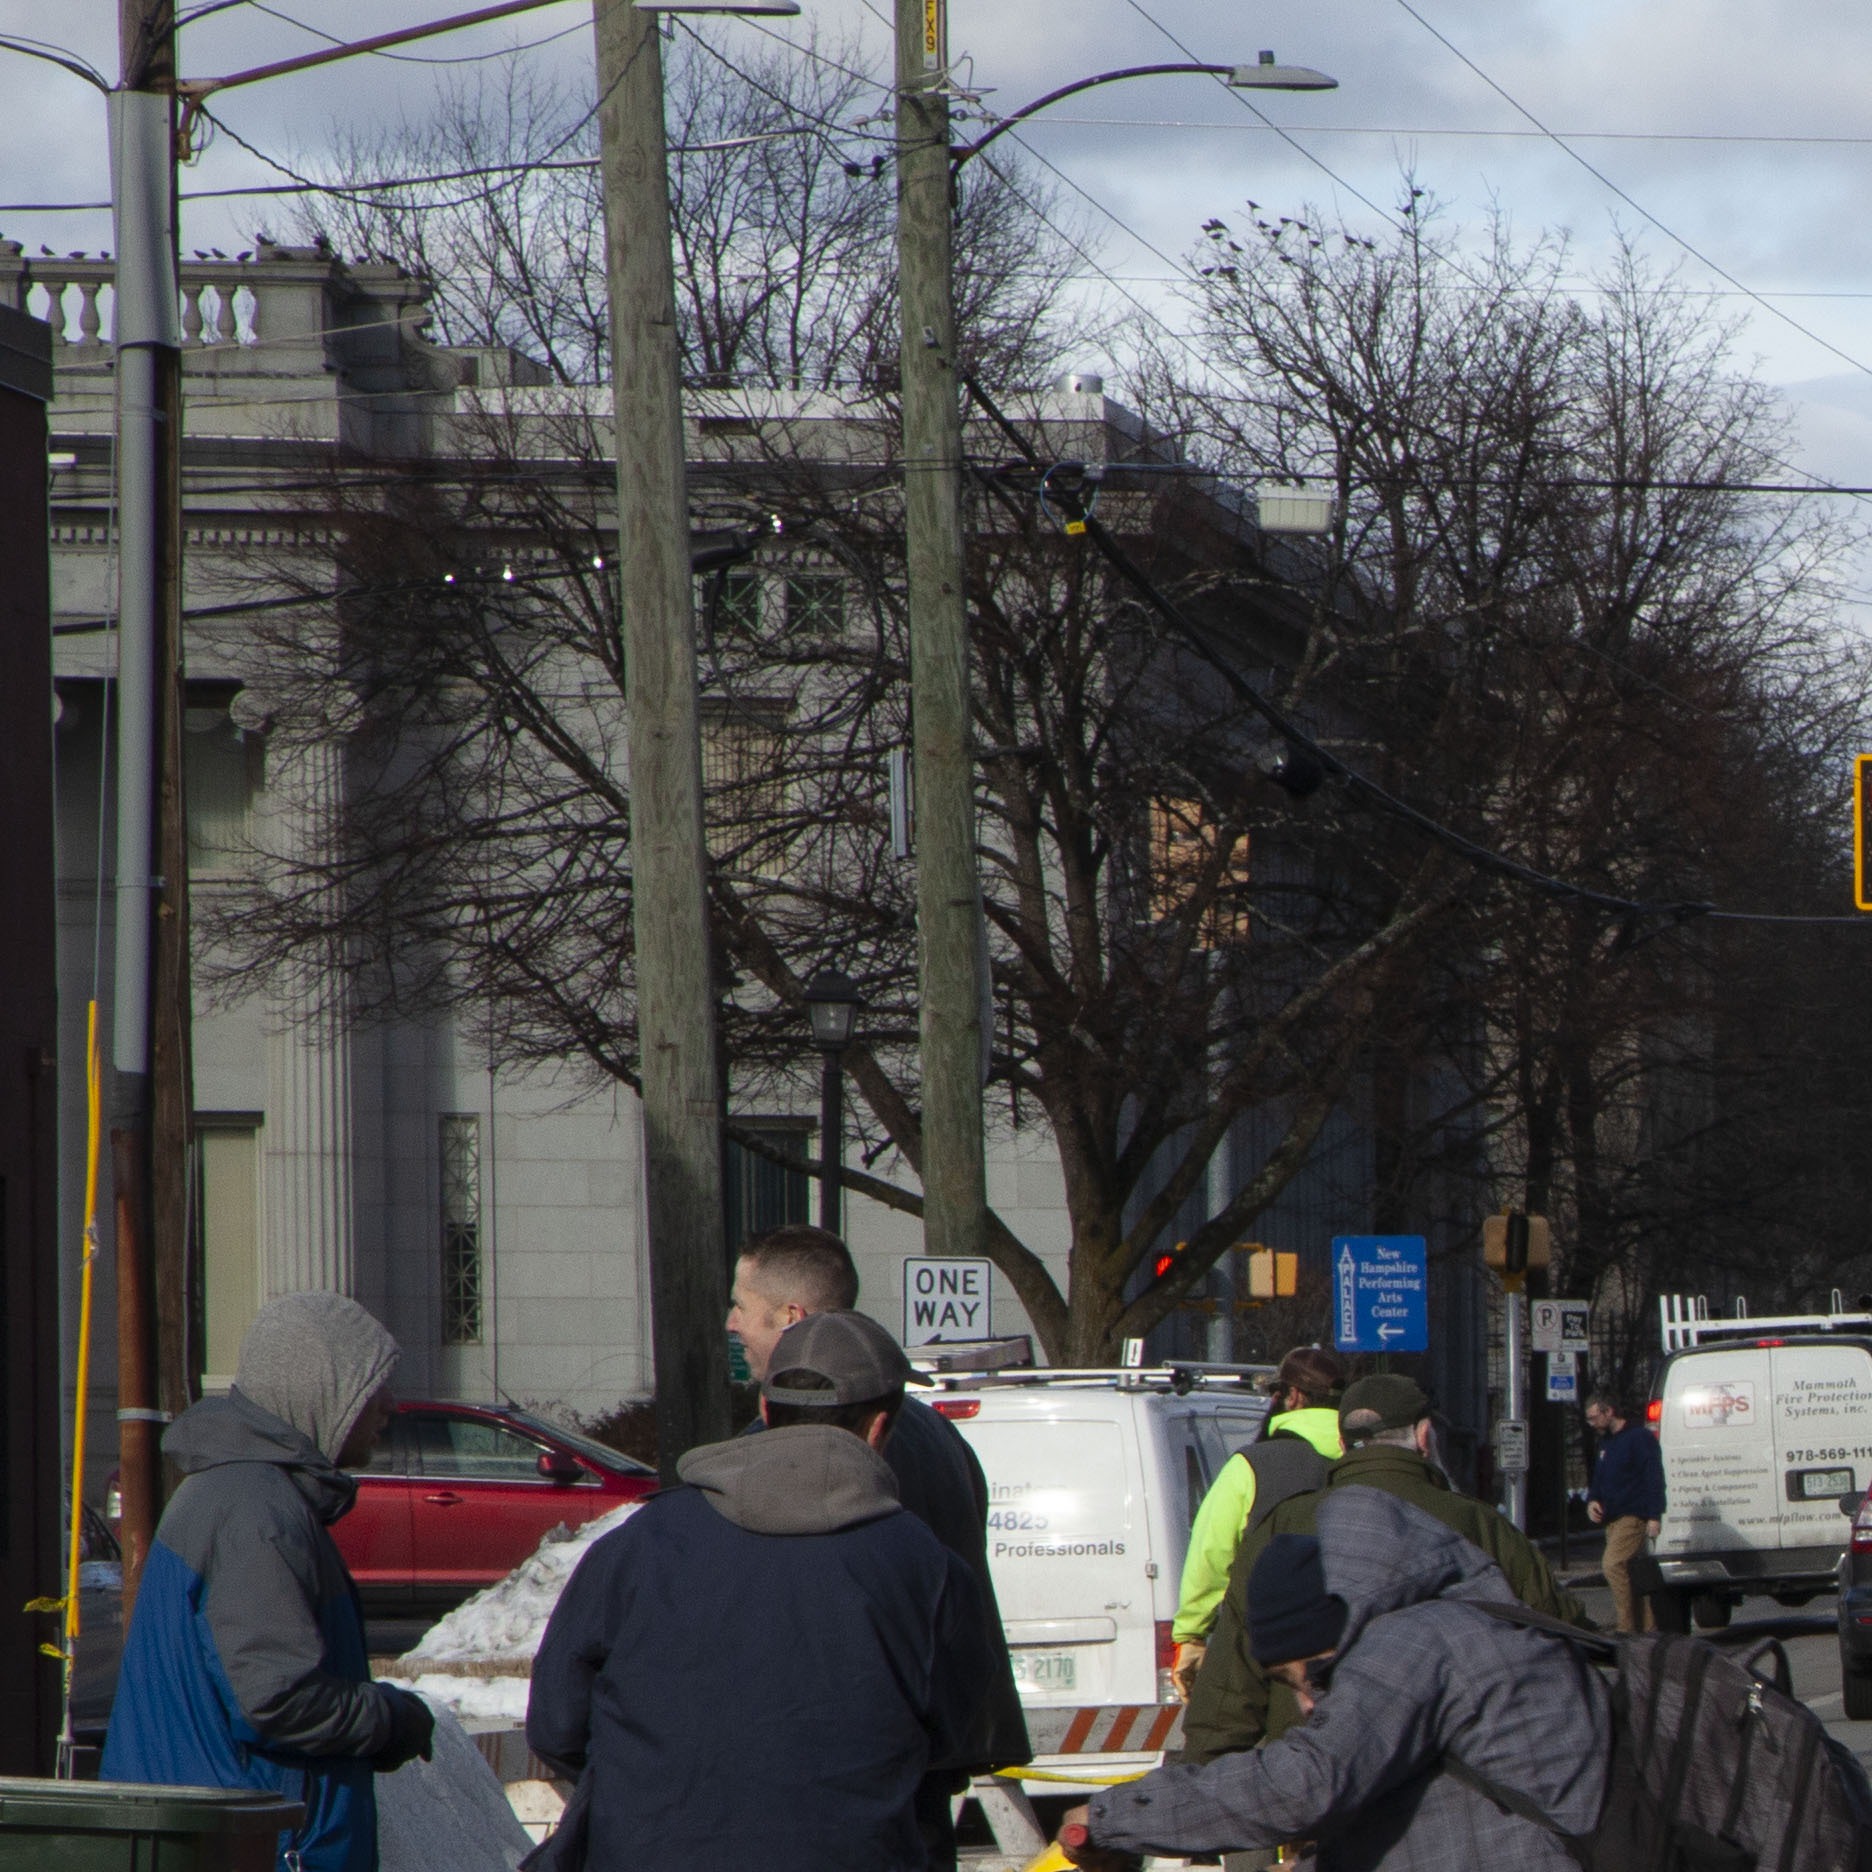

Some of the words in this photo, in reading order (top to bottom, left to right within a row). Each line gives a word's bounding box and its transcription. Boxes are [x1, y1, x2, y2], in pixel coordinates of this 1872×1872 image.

[1377, 1247, 1401, 1260] New
[1360, 1262, 1418, 1275] Hampshire
[916, 1268, 979, 1295] ONE
[1359, 1278, 1421, 1290] Performing
[1343, 1265, 1354, 1336] PALACE
[1378, 1292, 1403, 1303] Arts
[915, 1301, 980, 1327] WAY
[1371, 1306, 1409, 1318] Center
[1793, 1377, 1857, 1392] Mammoth
[1776, 1393, 1804, 1405] Fire
[1784, 1405, 1840, 1419] Systems,
[1844, 1403, 1868, 1414] inc.
[995, 1540, 1126, 1557] Professionals
